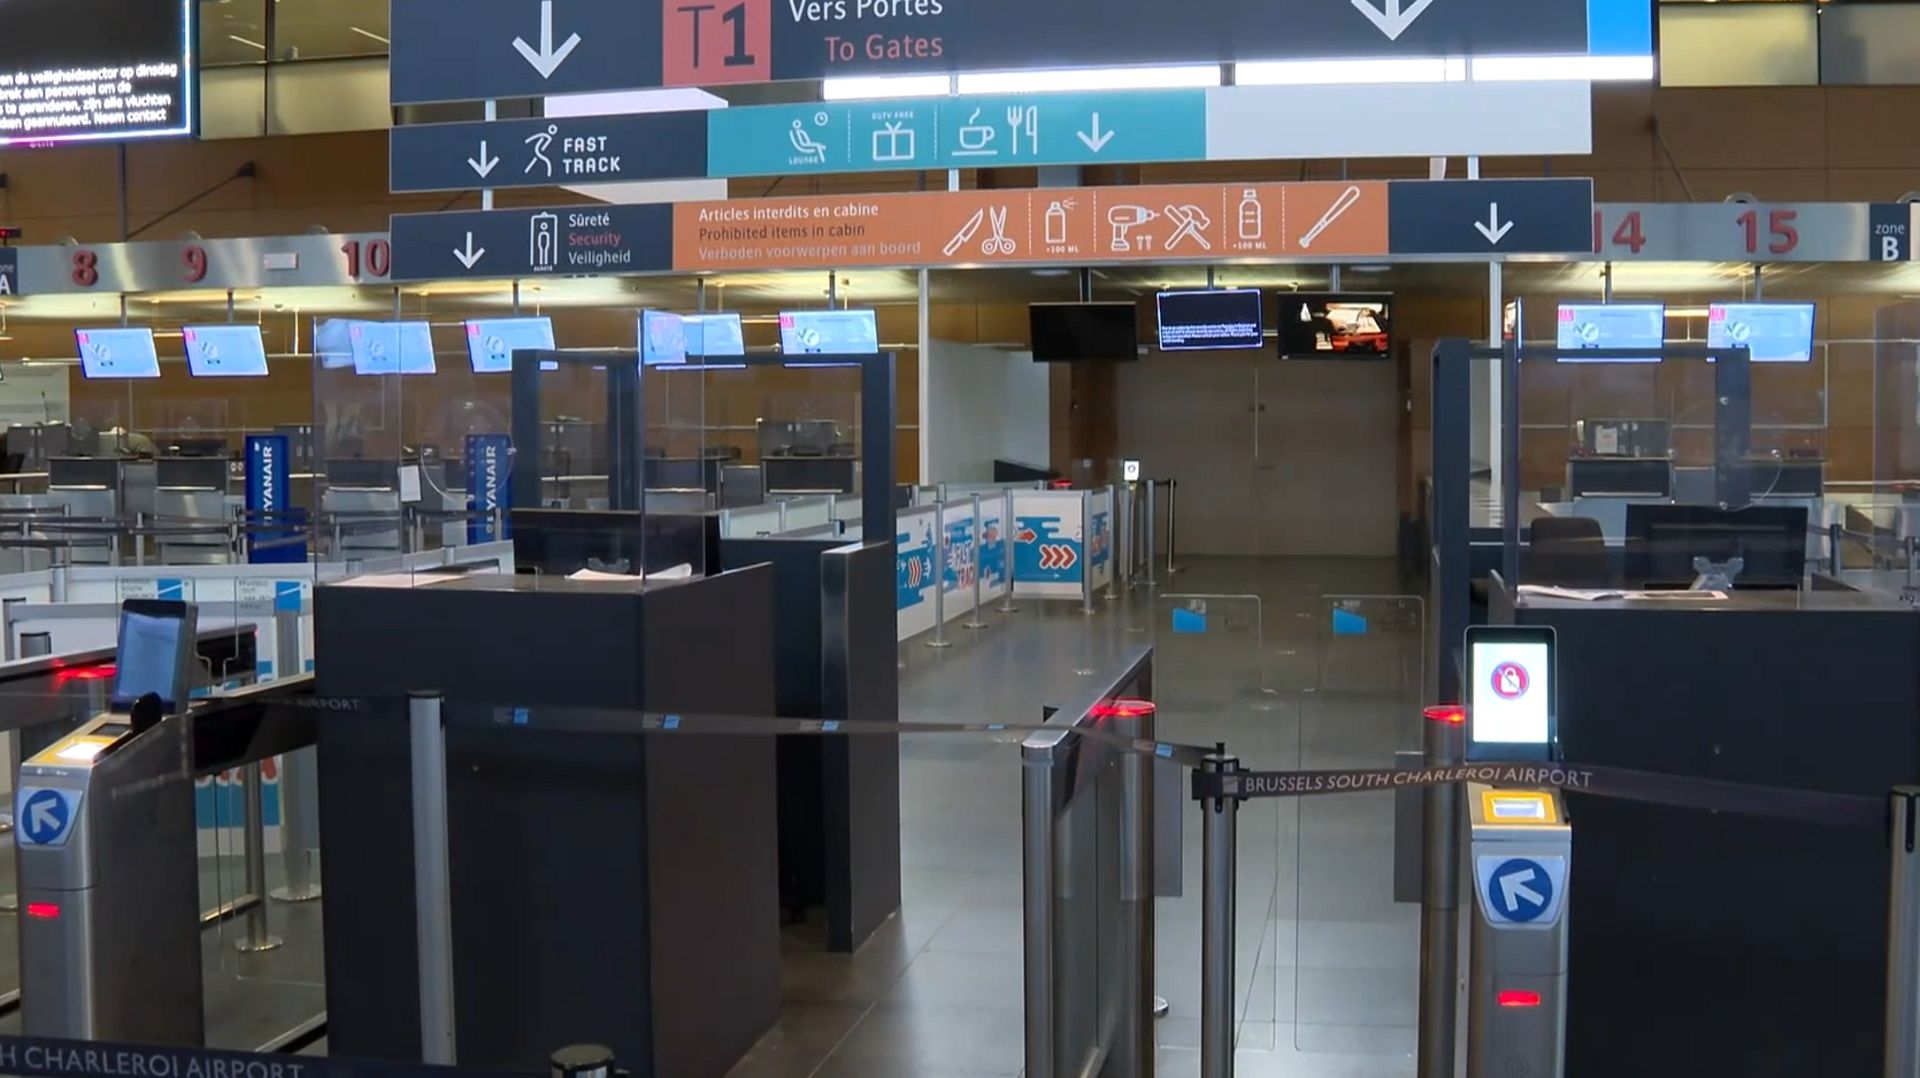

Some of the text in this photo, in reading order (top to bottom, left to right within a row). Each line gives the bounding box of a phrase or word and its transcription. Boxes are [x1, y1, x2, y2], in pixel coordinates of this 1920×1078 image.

[789, 0, 944, 22] Vers Portes
[677, 2, 756, 69] T1
[824, 34, 944, 62] To Gates
[15, 72, 29, 85] de
[31, 68, 119, 86] veiligheidssector
[120, 67, 134, 80] op
[136, 62, 178, 78] dinsdag
[45, 82, 96, 101] personeel
[98, 83, 116, 95] om
[117, 80, 132, 93] de
[5, 102, 17, 115] te
[125, 93, 172, 109] vluchten
[94, 111, 125, 125] Neem
[127, 108, 167, 123] contact
[563, 136, 608, 154] FAST
[562, 156, 621, 175] TRACK
[568, 211, 611, 228] Sûreté
[698, 203, 880, 223] Articles interdits en cabine
[698, 222, 866, 241] Prohibited items in cabin
[1736, 210, 1799, 254] 15
[1874, 222, 1905, 235] zone
[568, 231, 622, 248] Security
[1881, 236, 1899, 261] B
[340, 239, 389, 278] 10
[568, 248, 632, 268] Veiligheid
[698, 241, 922, 261] Verboden voorwerpen aan boord
[71, 249, 99, 287] 8
[181, 245, 207, 283] 9
[0, 274, 11, 295] A
[1245, 766, 1594, 793] BRUSSELS SOUTH CHARLEROI AIRPORT
[24, 1046, 179, 1078] CHARLEROI
[186, 1057, 304, 1078] AIRPORT
